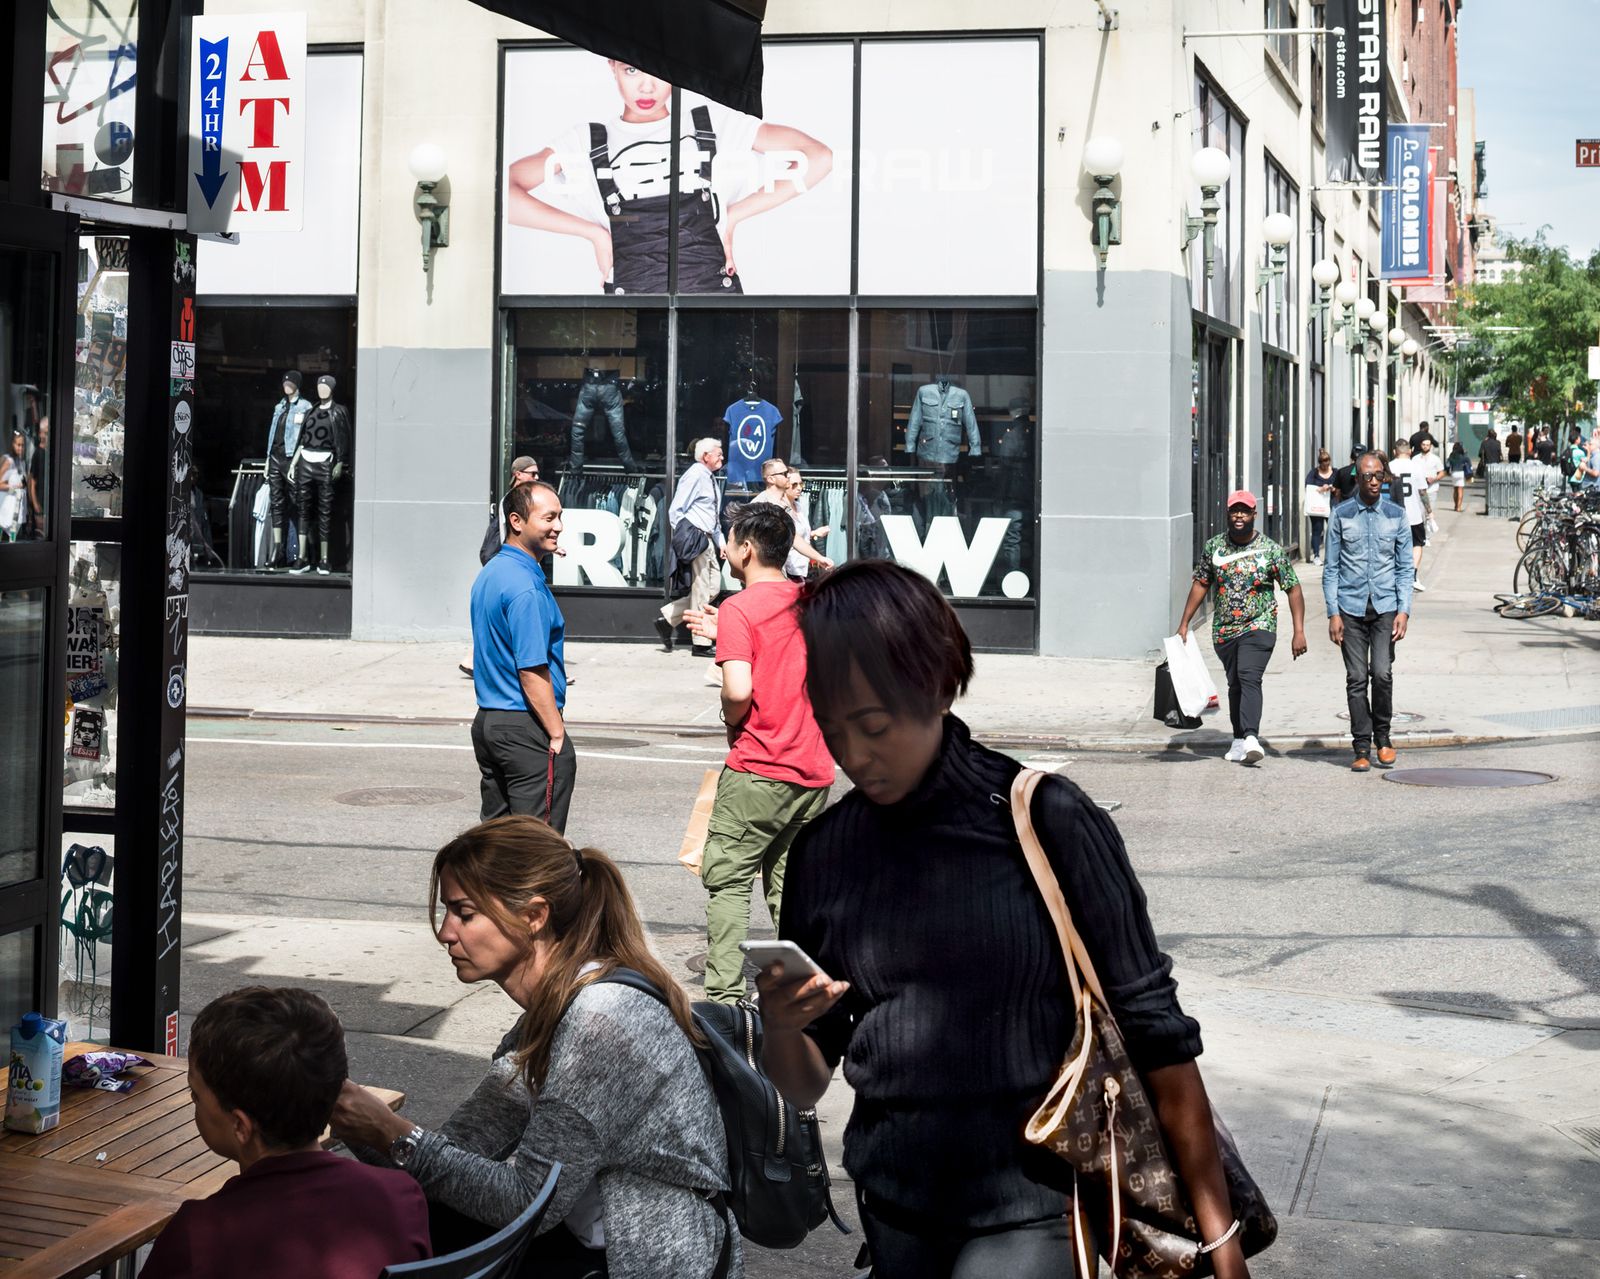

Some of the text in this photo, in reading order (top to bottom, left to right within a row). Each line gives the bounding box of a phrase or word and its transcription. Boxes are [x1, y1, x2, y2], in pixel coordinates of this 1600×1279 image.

[234, 30, 291, 212] ATM
[1358, 92, 1380, 169] RAW
[1402, 138, 1420, 266] La COLOMBE
